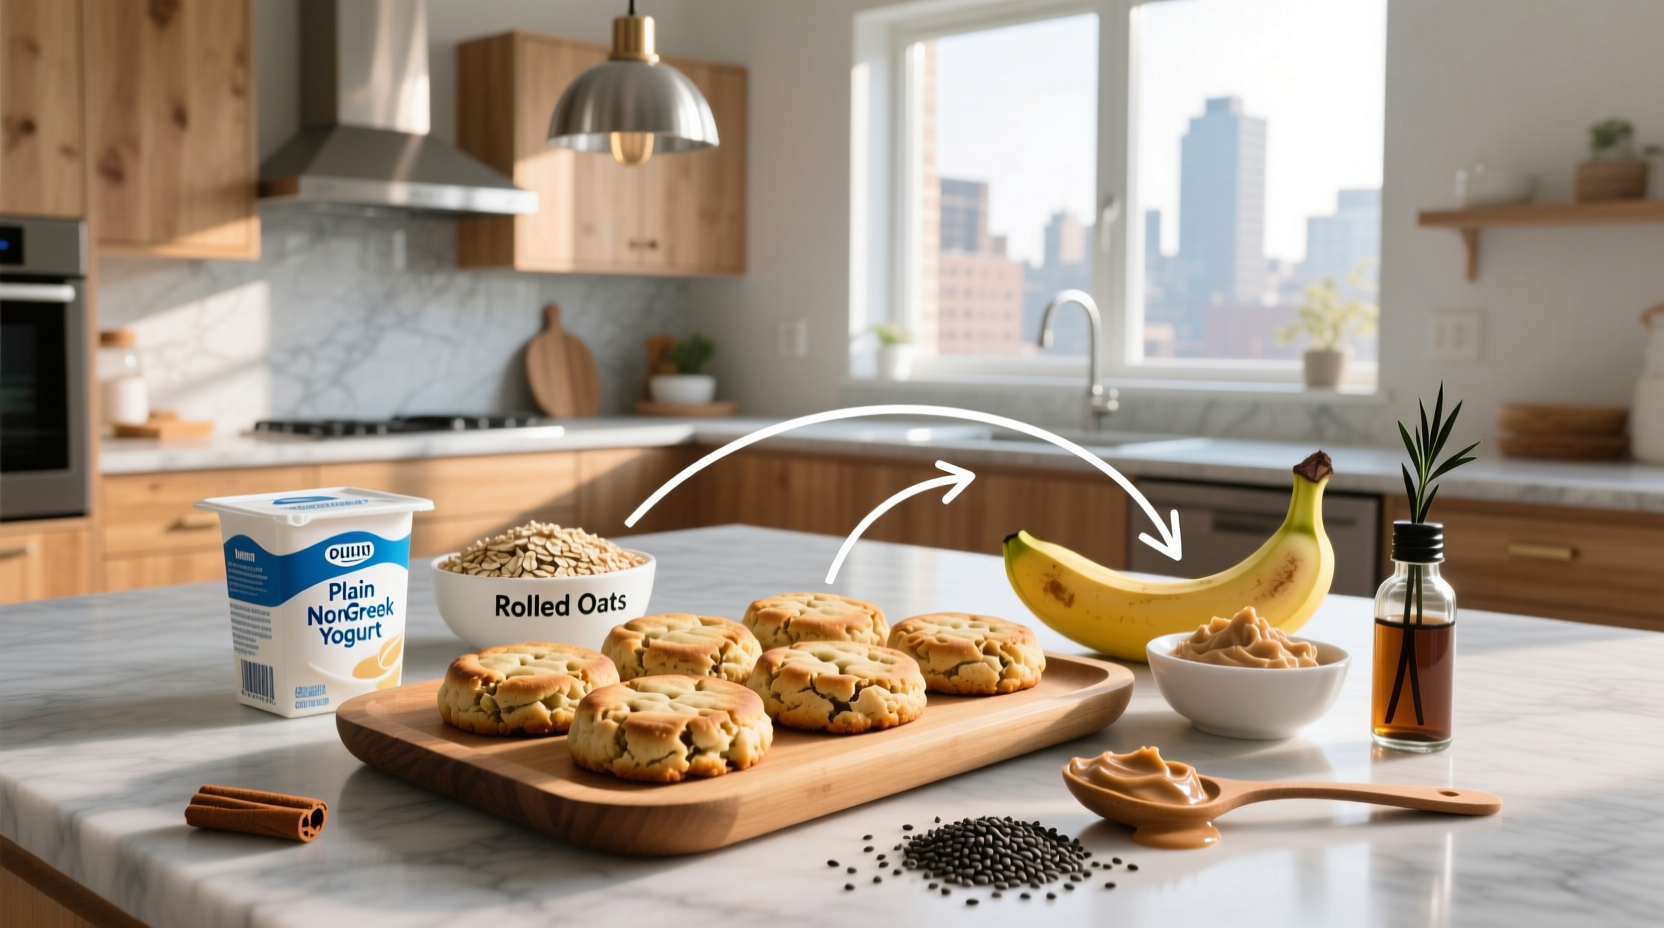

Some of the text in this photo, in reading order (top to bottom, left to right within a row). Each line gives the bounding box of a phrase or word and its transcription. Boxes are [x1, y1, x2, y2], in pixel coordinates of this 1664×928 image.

[329, 579, 375, 602] Plain
[495, 592, 627, 617] Rolled Oats
[319, 621, 382, 648] Yogurt
